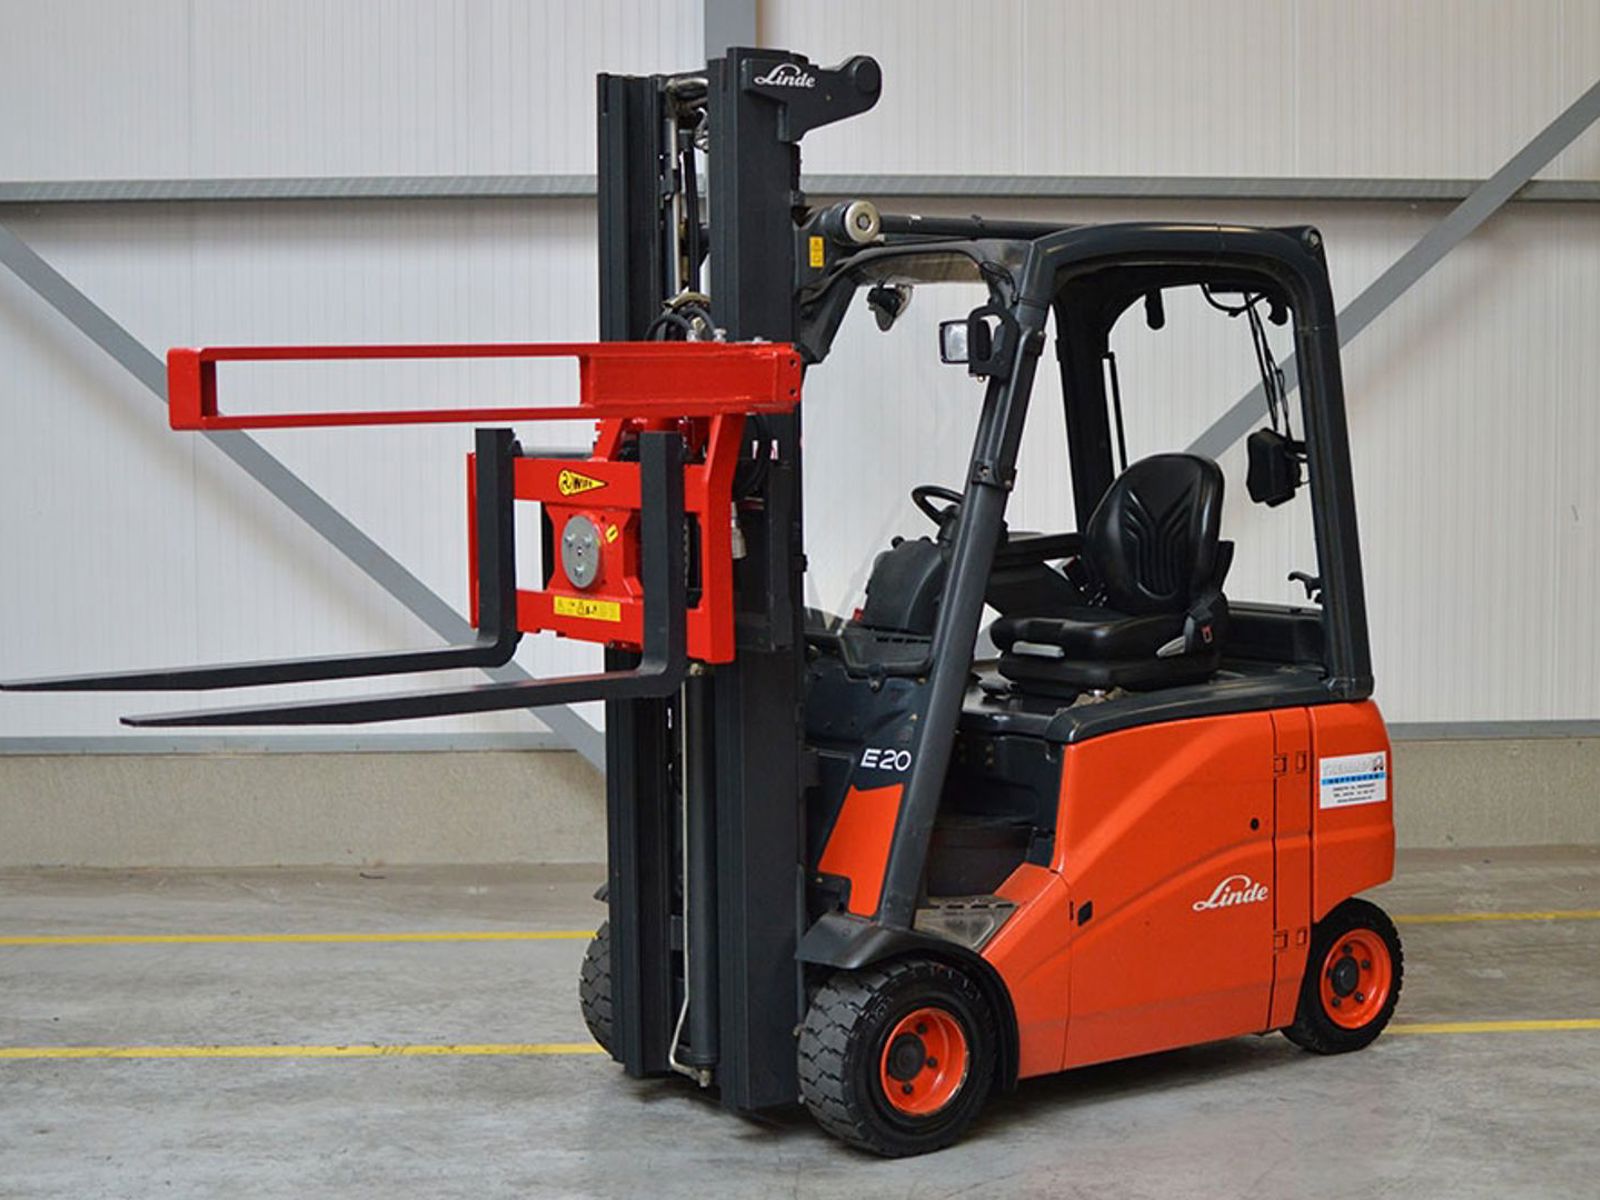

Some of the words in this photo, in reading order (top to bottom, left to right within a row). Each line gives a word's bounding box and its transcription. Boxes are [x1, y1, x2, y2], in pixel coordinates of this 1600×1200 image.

[753, 62, 816, 88] Linde
[860, 748, 912, 772] E20
[1192, 874, 1269, 911] Linde
